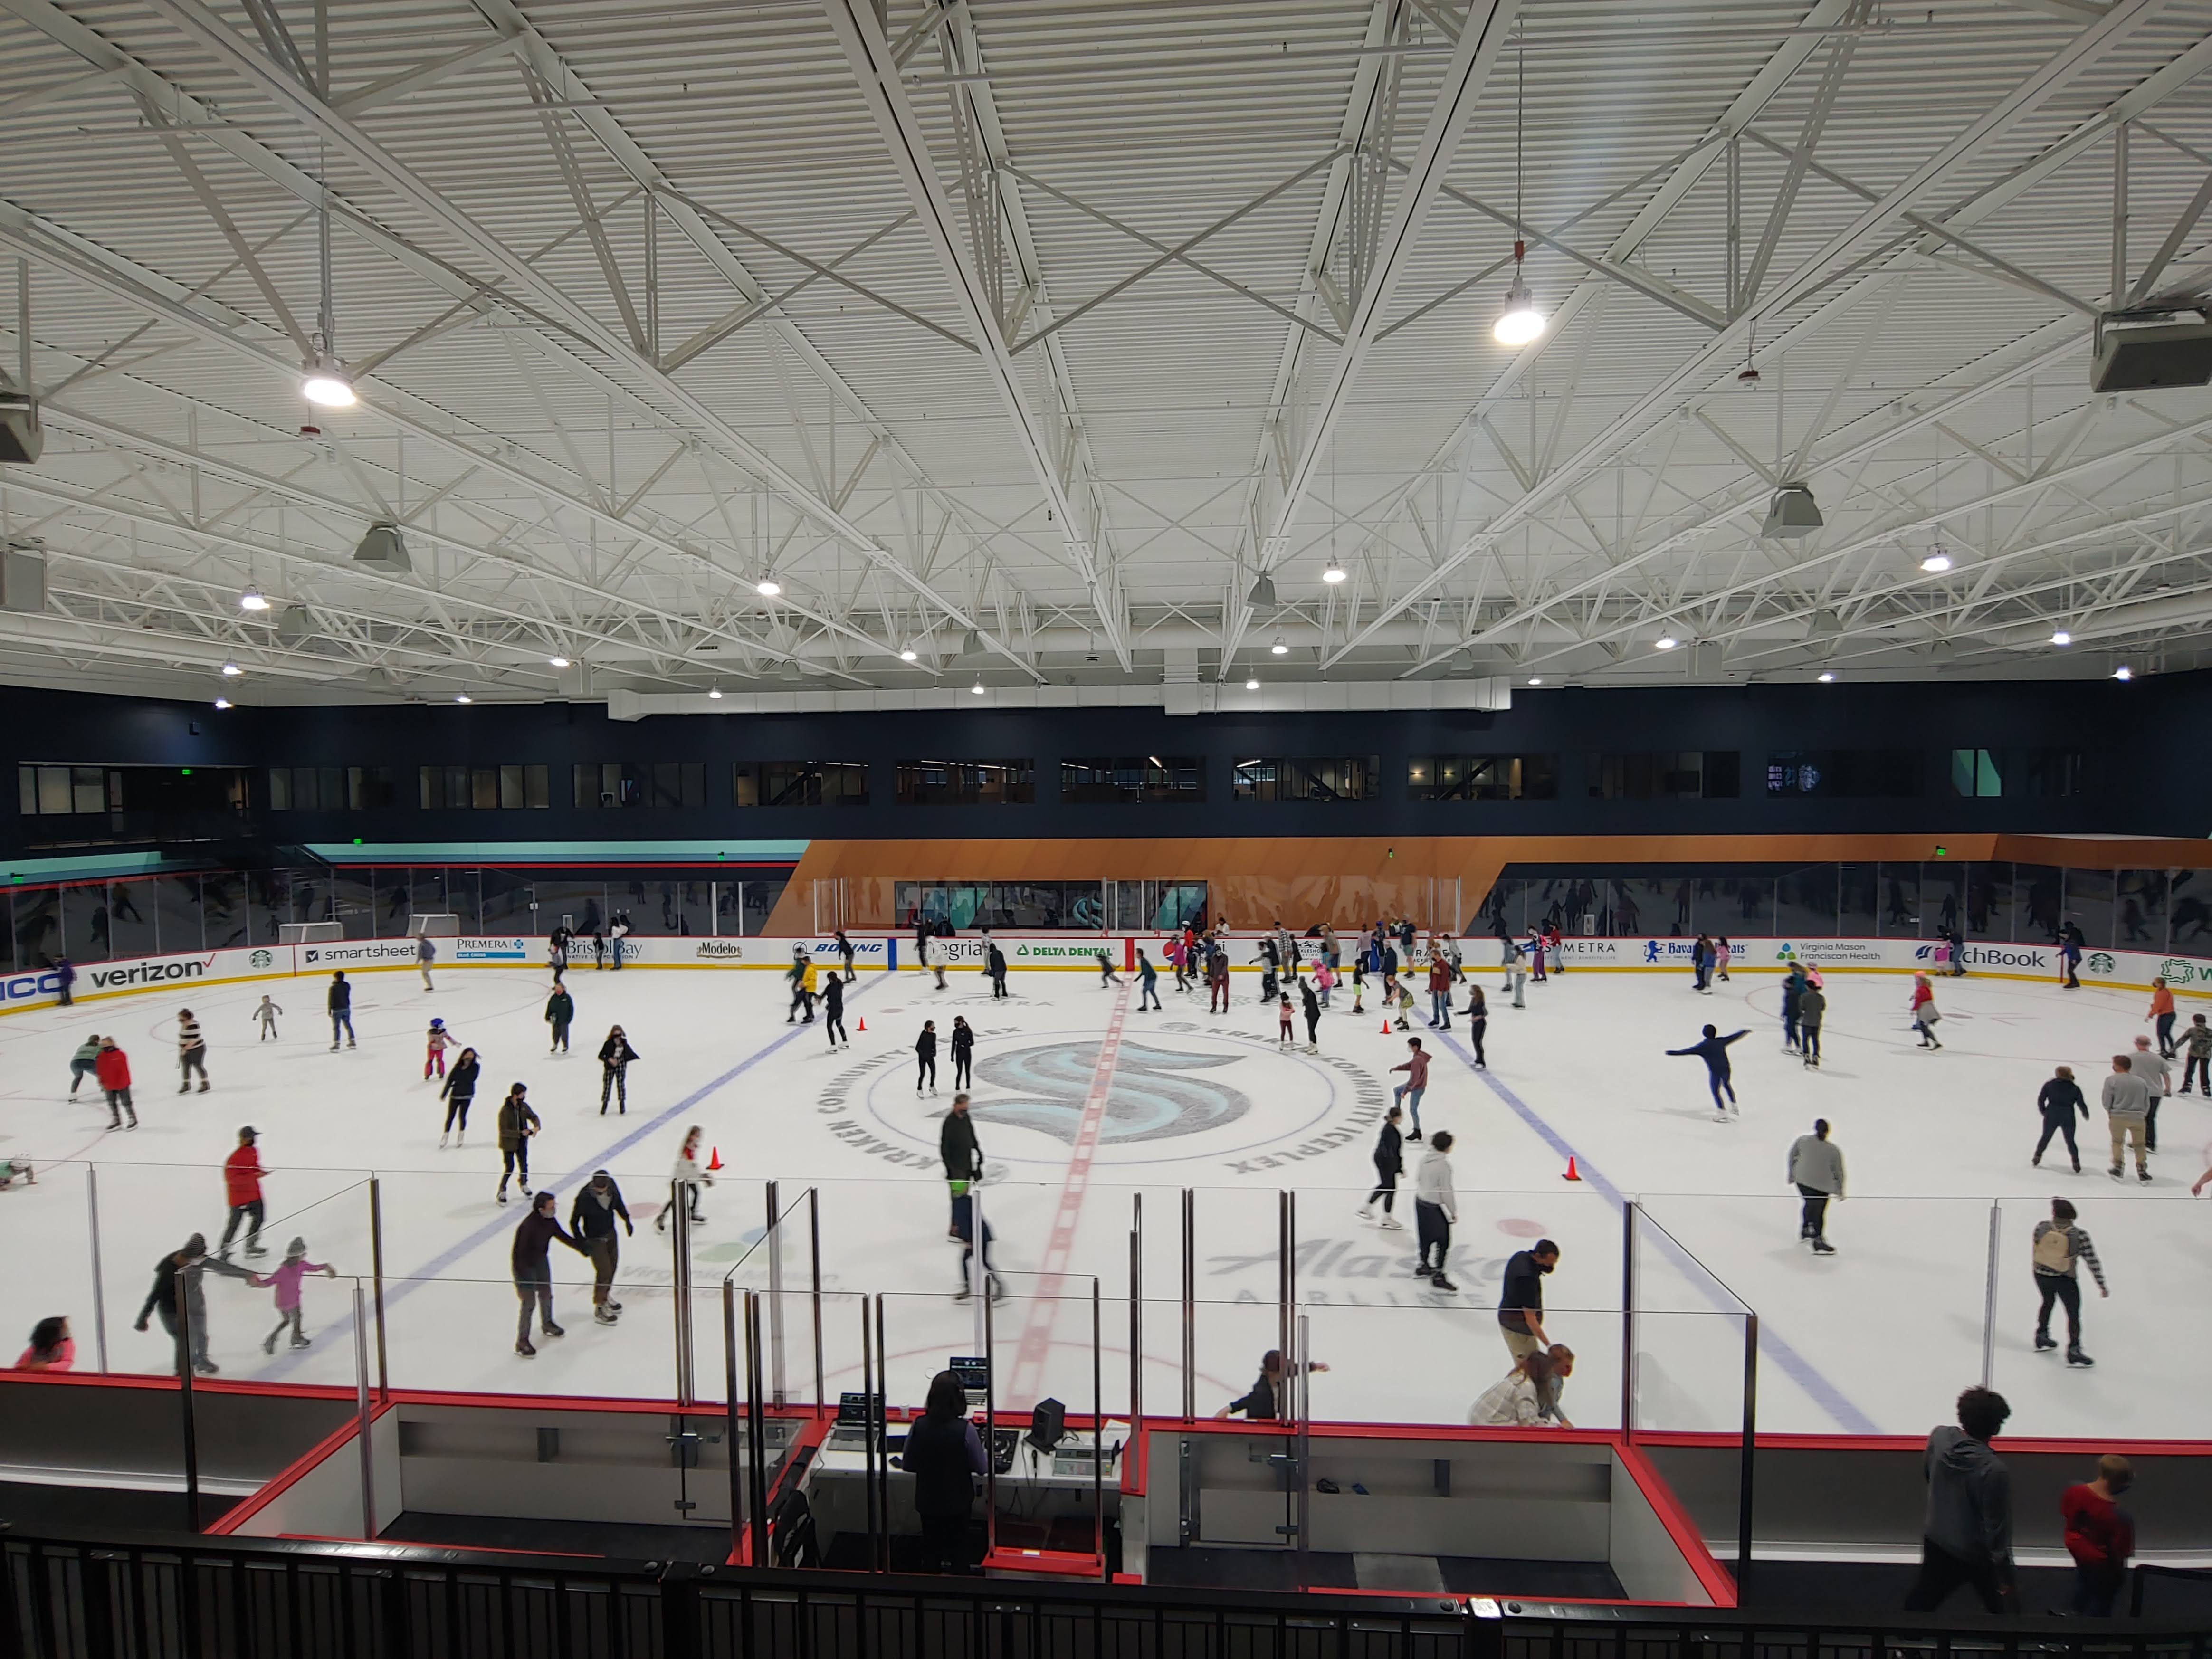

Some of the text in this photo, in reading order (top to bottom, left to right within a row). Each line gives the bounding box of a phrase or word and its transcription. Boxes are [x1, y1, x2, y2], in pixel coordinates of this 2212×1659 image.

[457, 939, 507, 949] PREMERA
[702, 942, 736, 954] Modelo
[814, 944, 883, 952] BOING
[1545, 943, 1615, 953] SMETRA
[1800, 943, 1833, 952] Virginia
[325, 944, 416, 960] smartsheet
[1033, 947, 1113, 956] DELTA DENTAL
[90, 962, 202, 988] verizon
[817, 1049, 908, 1114] COMMUNITY
[1322, 1057, 1384, 1127] COMMUNITY
[1224, 1127, 1363, 1174] ICEPLEX
[1206, 1239, 1507, 1287] Alaska
